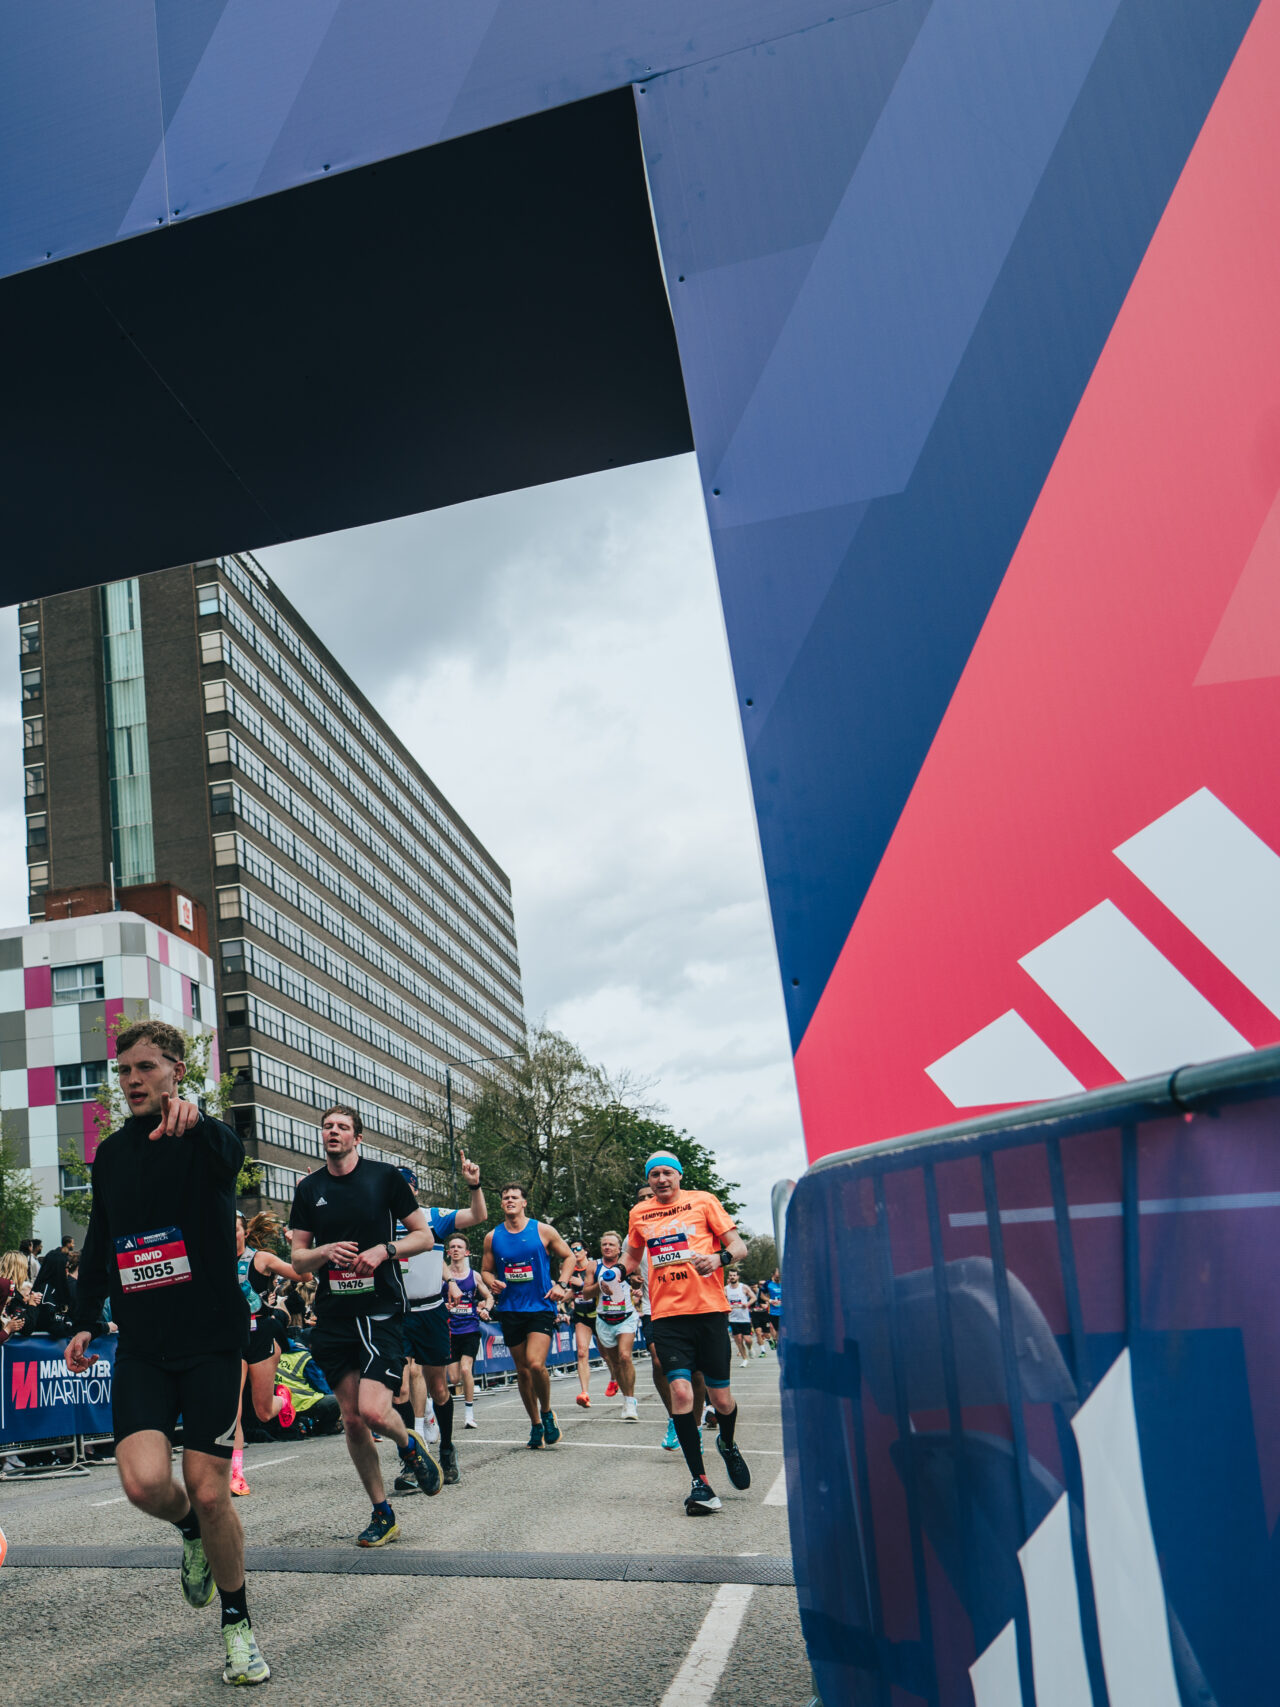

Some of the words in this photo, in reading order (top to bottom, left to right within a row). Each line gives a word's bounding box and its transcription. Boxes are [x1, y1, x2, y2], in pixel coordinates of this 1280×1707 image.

[134, 1250, 163, 1263] DAVID
[657, 1252, 681, 1262] 16074
[132, 1262, 174, 1281] 31055
[338, 1280, 364, 1289] 19476
